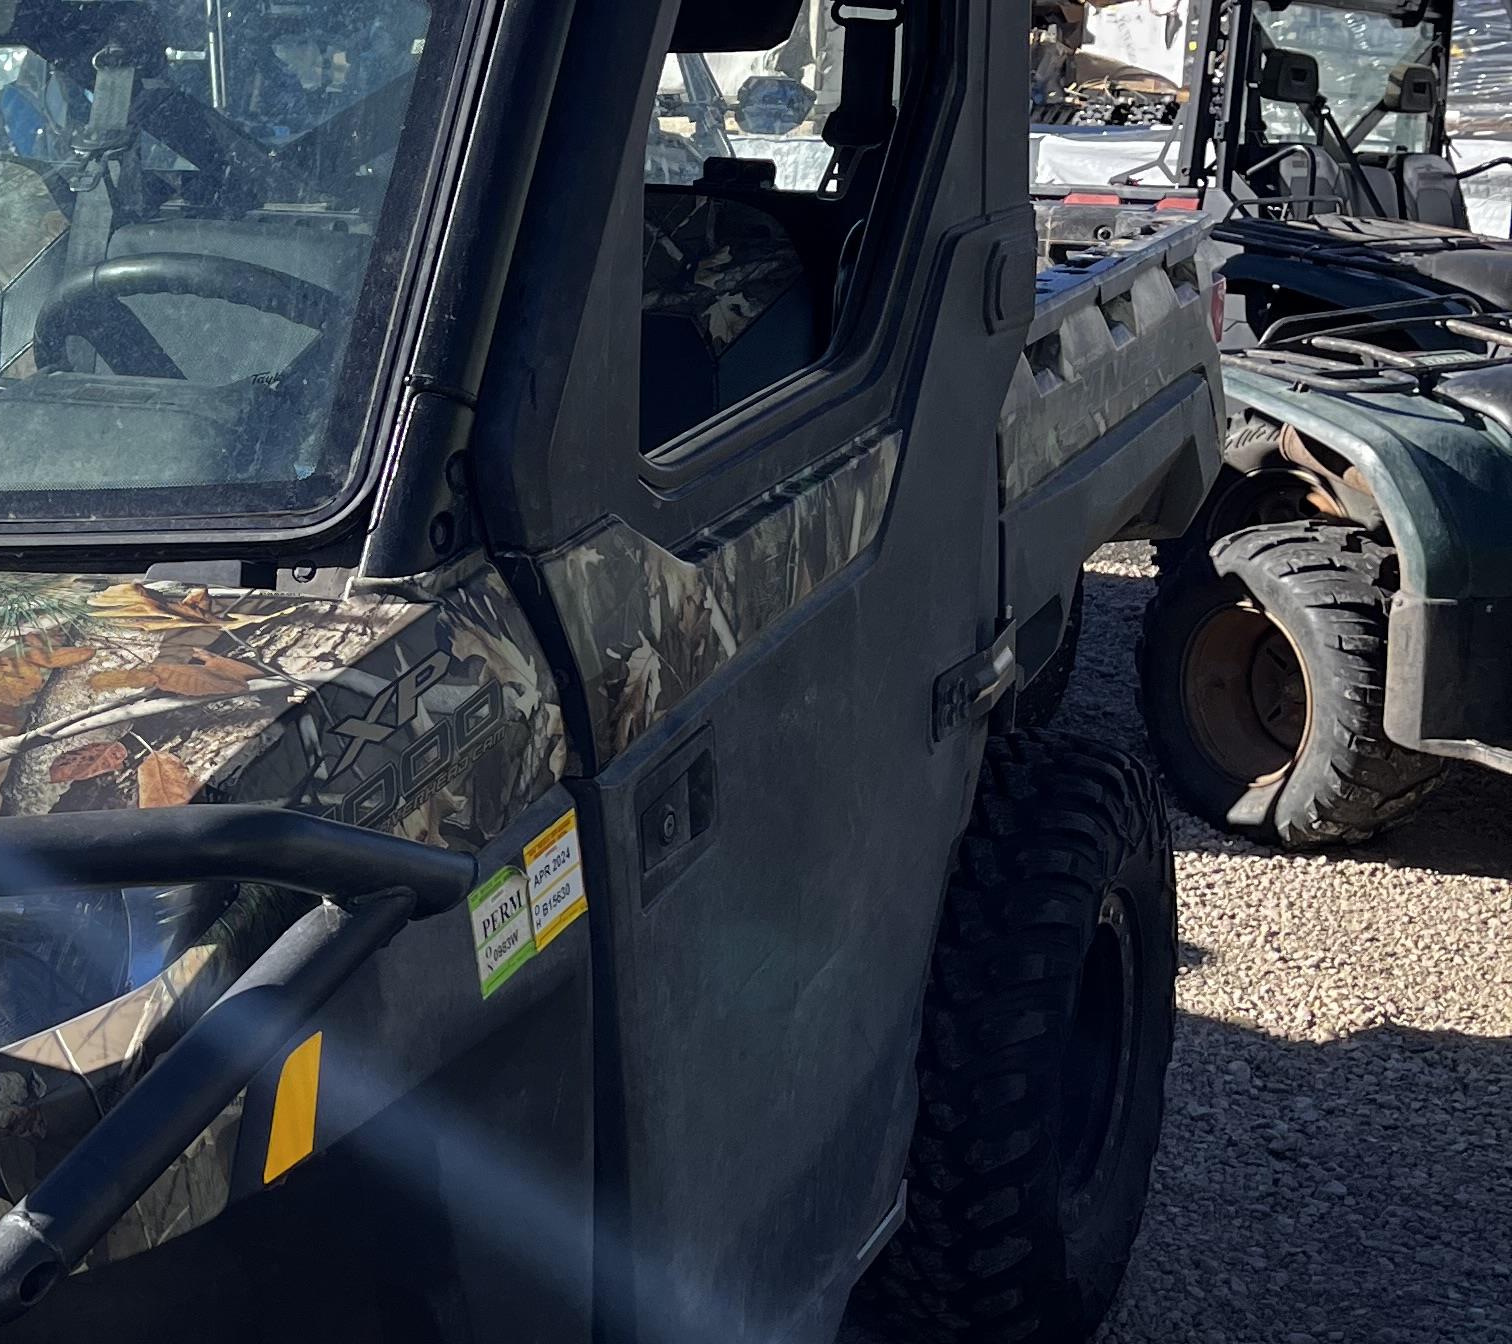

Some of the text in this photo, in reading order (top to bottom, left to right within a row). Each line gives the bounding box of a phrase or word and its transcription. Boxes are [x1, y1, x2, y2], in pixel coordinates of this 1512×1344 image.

[320, 678, 504, 828] 000
[326, 650, 451, 787] XP
[482, 889, 524, 939] PERM
[533, 864, 551, 888] APR
[552, 847, 571, 873] 2024
